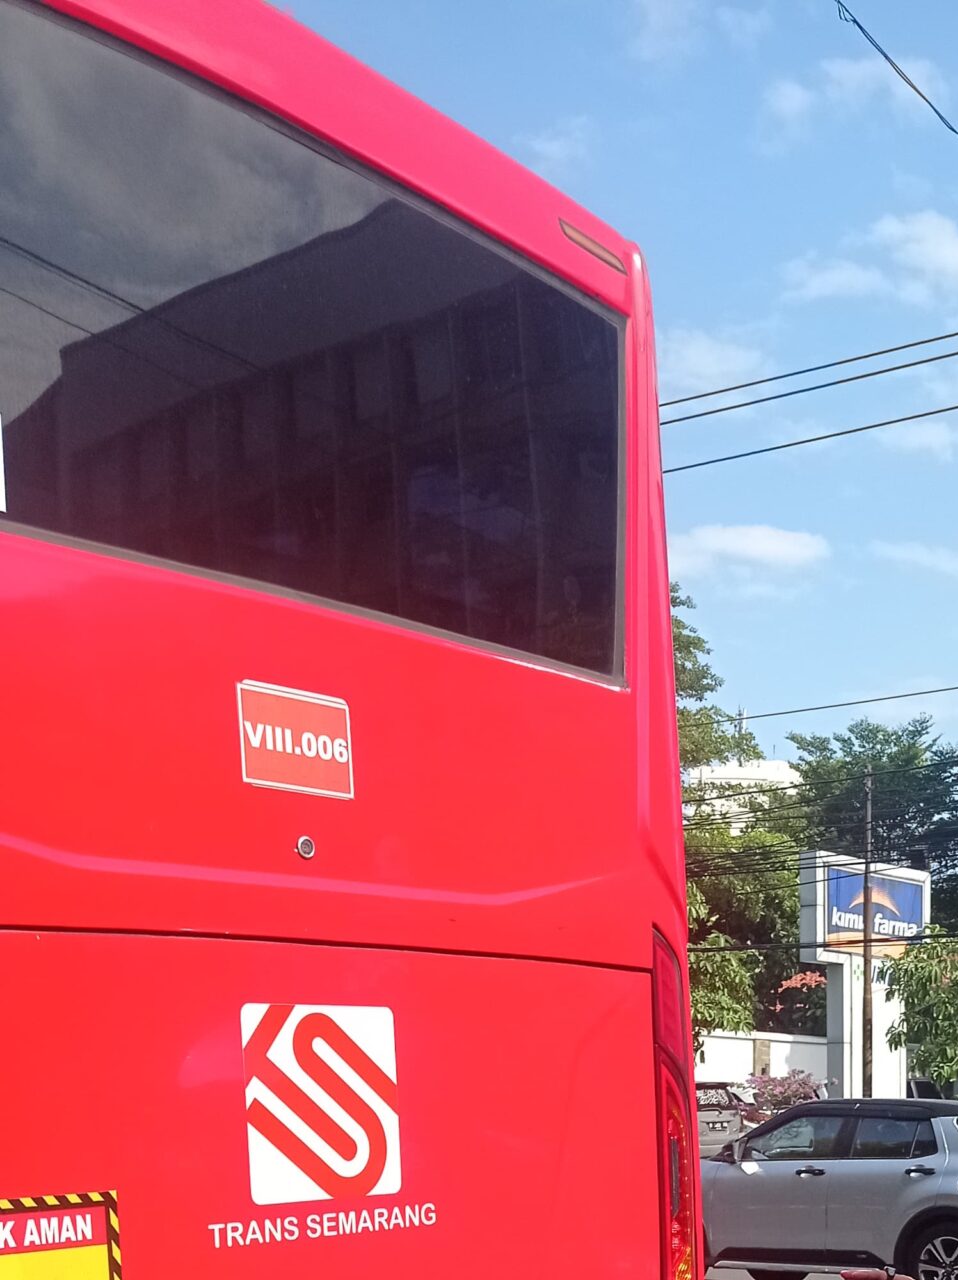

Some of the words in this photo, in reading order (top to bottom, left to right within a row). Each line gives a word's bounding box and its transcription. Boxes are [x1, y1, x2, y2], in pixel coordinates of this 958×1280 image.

[243, 719, 349, 764] VIII.006
[873, 912, 918, 937] farma
[23, 1212, 93, 1247] AMAN
[207, 1216, 299, 1249] TRANS
[306, 1202, 437, 1239] SEMARANG
